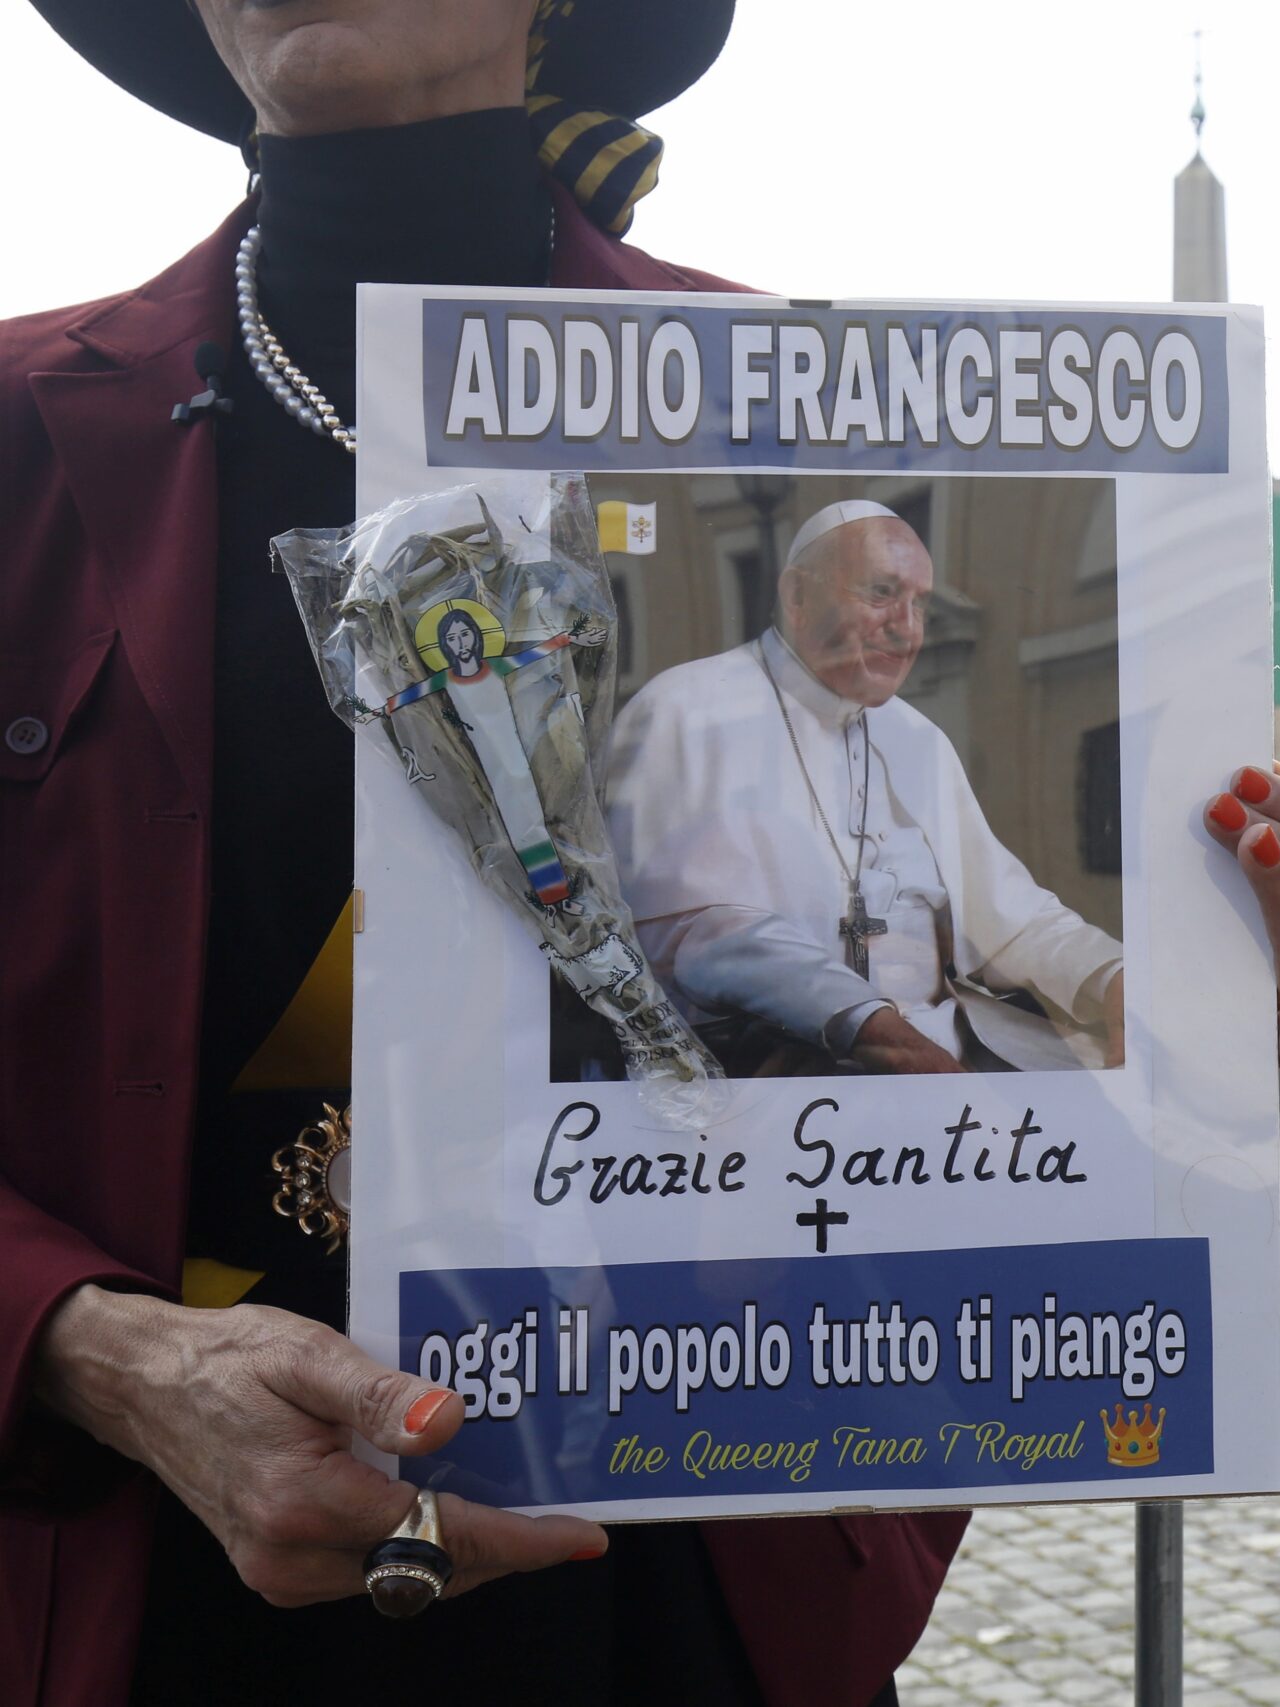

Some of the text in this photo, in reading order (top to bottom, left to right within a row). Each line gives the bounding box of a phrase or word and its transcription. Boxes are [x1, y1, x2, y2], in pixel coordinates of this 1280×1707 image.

[443, 313, 1204, 452] ADDIO FRANCESCO
[533, 1098, 1088, 1207] Grazie Santita
[418, 1293, 1188, 1420] oggi il popolo tutto ti piange
[608, 1435, 668, 1476] the
[682, 1430, 820, 1483] Queeng
[832, 1424, 927, 1468] Tana
[975, 1420, 1085, 1470] Royal
